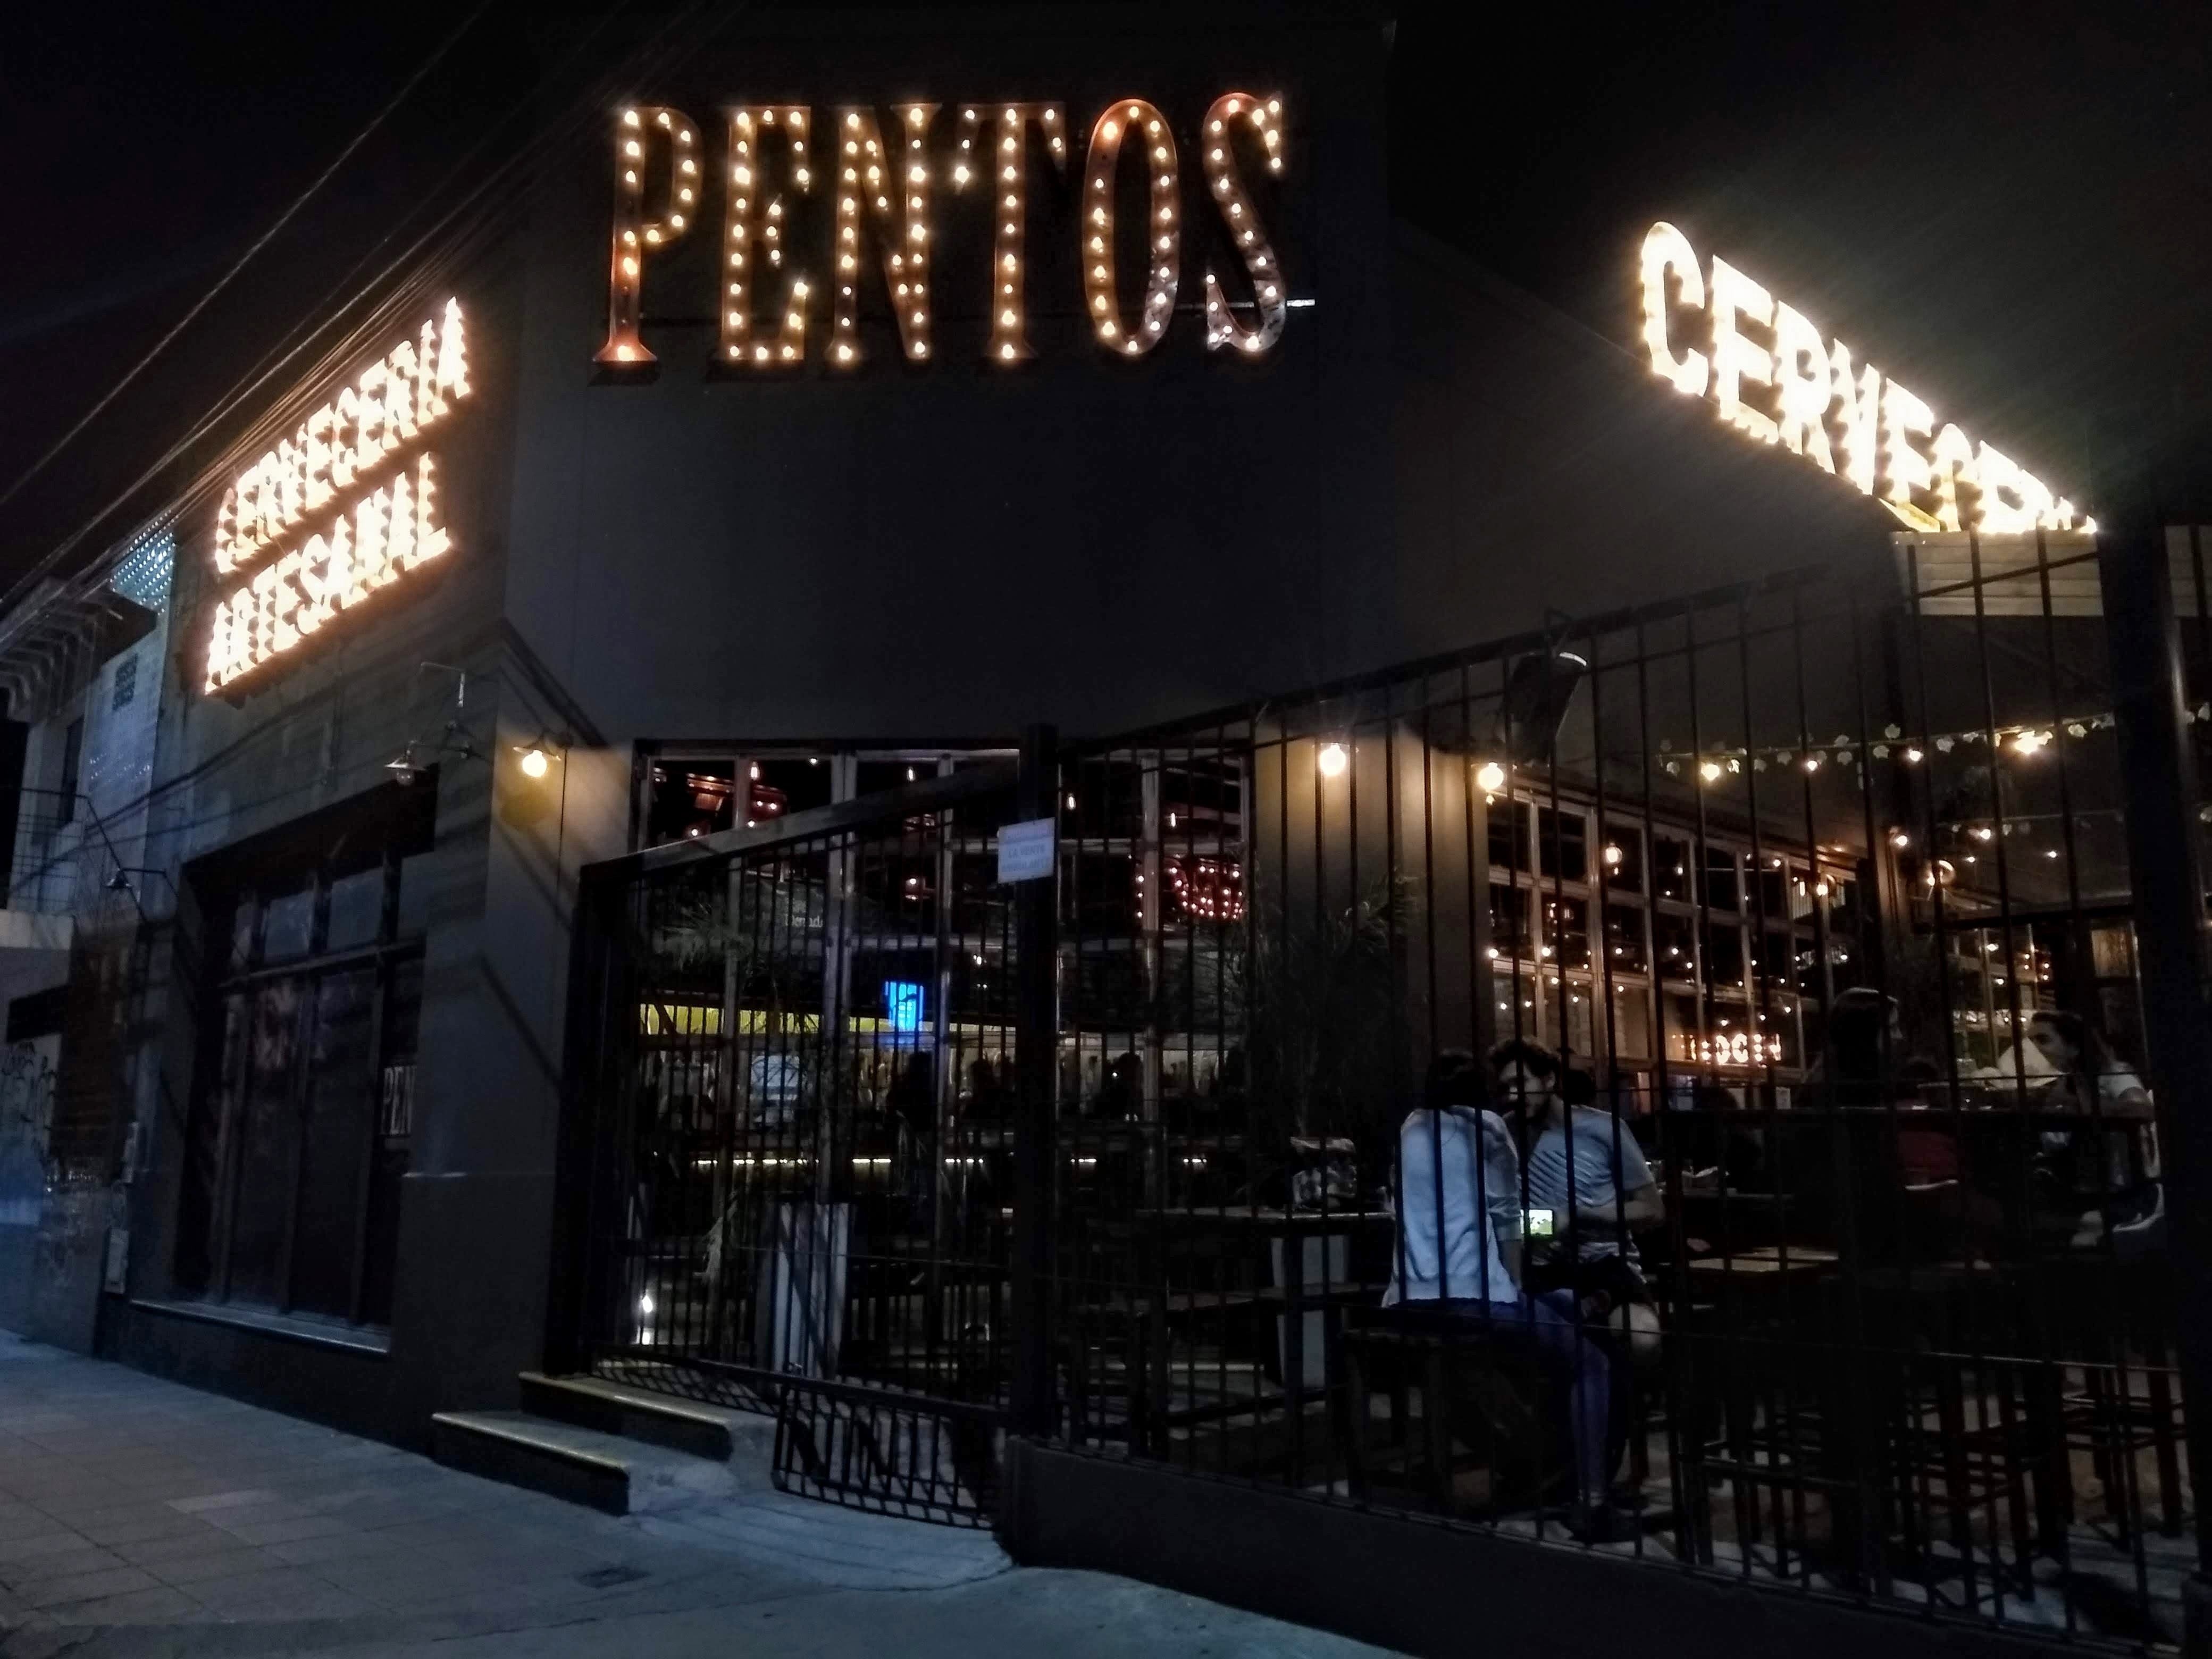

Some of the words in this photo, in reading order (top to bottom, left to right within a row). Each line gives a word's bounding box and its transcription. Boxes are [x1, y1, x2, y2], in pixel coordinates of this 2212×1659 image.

[592, 91, 1286, 363] PENTOS
[1640, 221, 2098, 534] CERVECER
[205, 452, 453, 696] ARTESANAL
